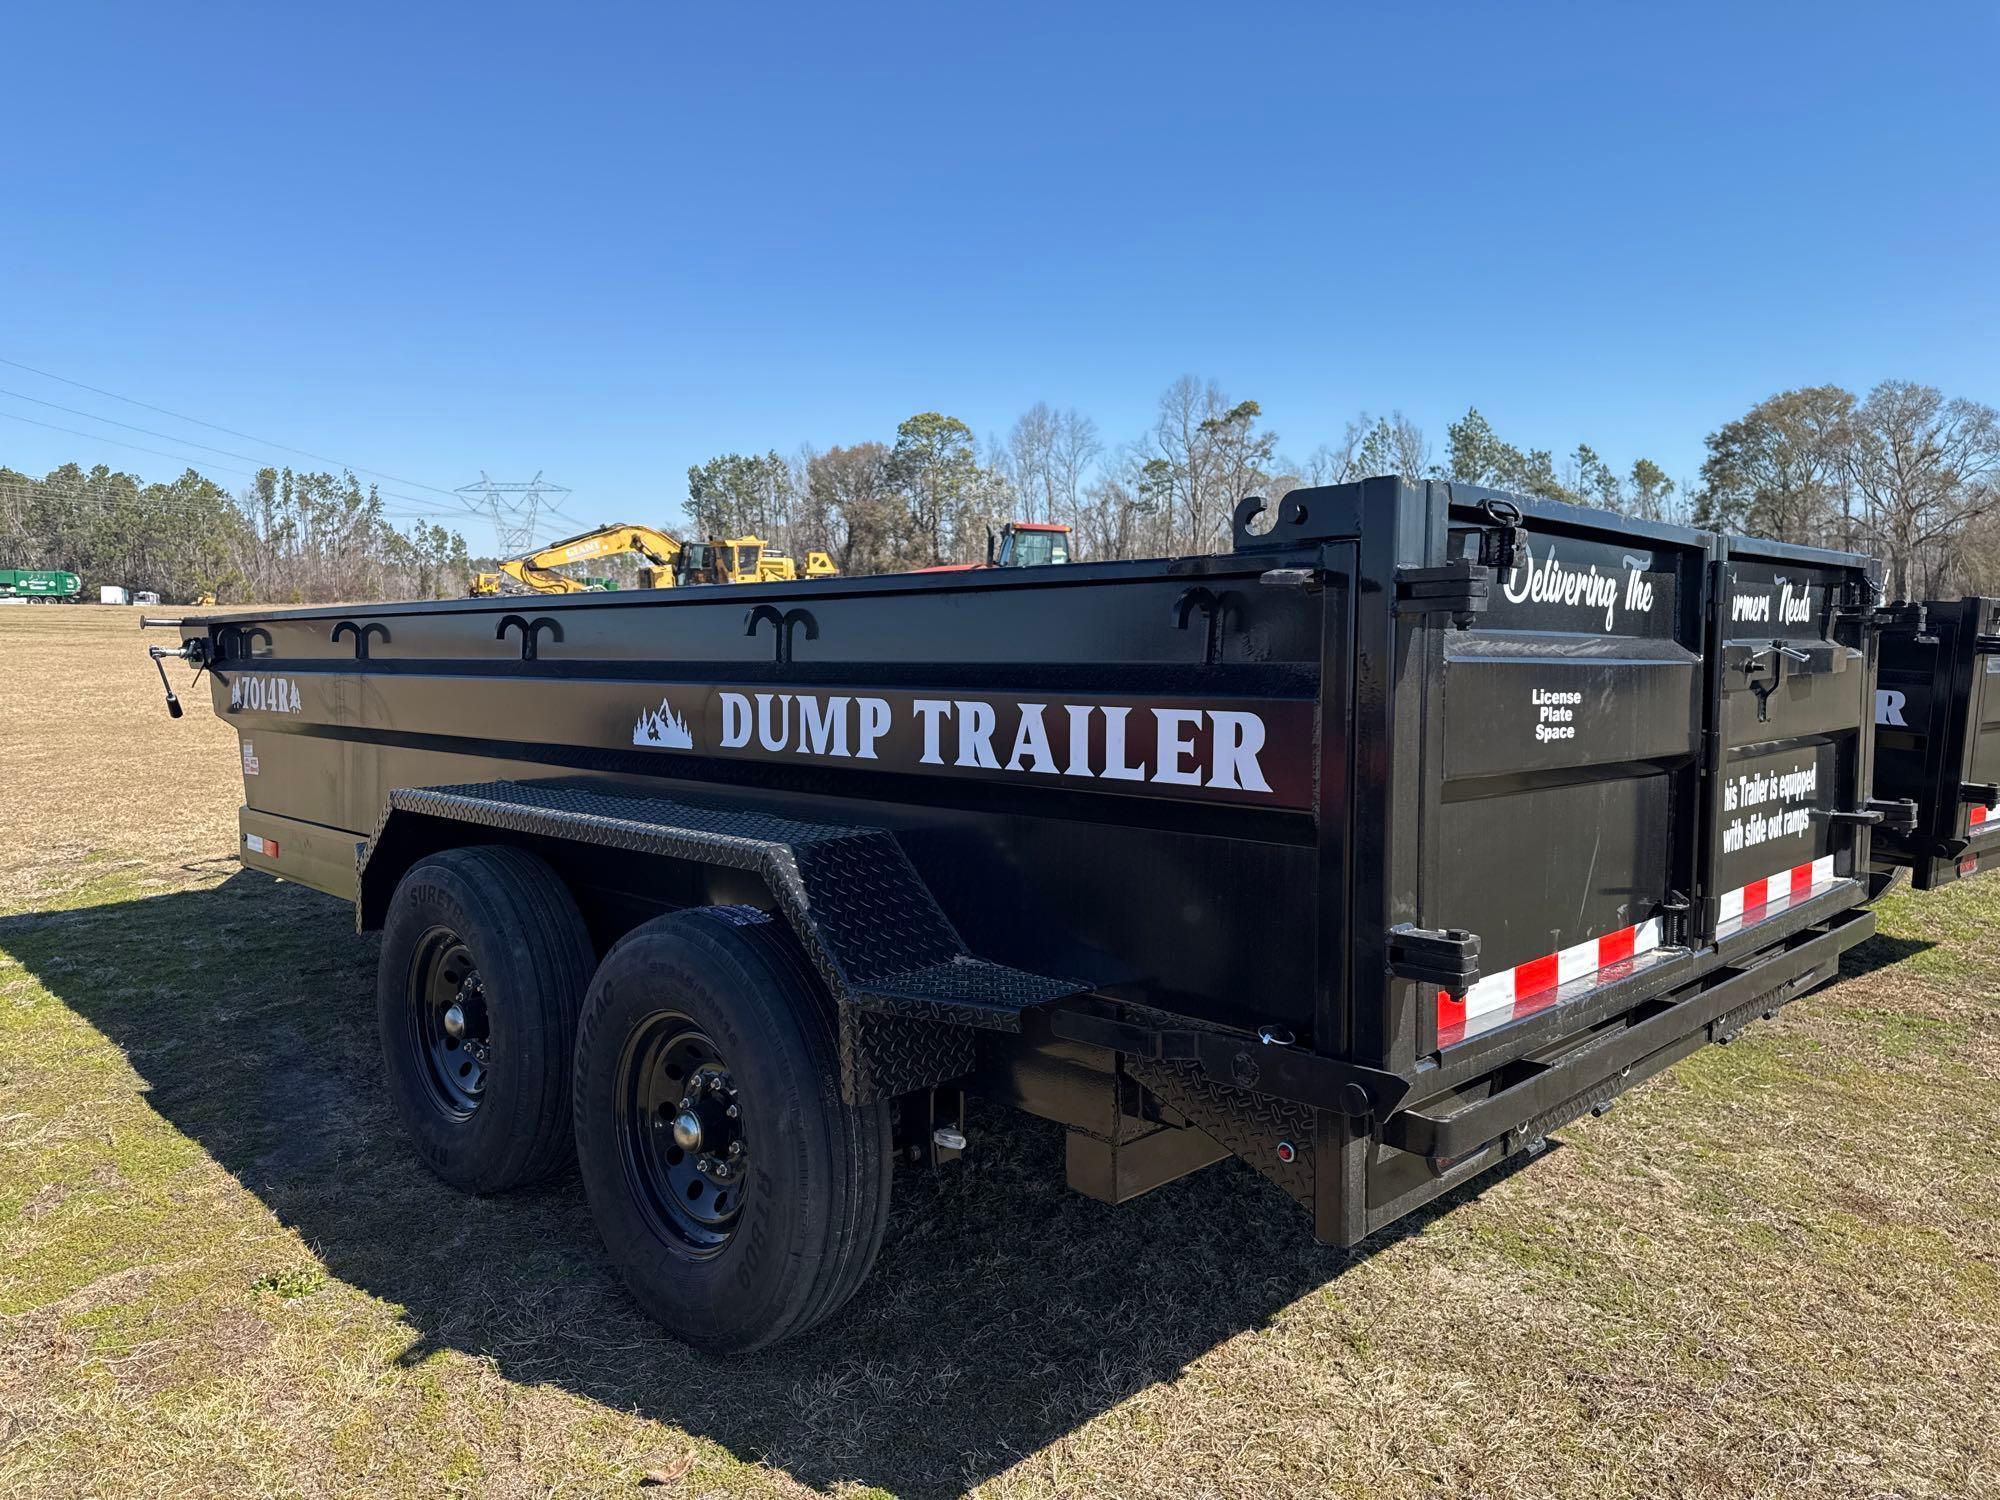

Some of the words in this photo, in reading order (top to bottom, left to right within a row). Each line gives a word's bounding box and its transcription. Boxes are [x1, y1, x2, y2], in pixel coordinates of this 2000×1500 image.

[1503, 544, 1618, 631] Delivering
[1623, 555, 1653, 612] The
[1774, 573, 1810, 625] Needs
[242, 677, 290, 712] 7014R
[1532, 688, 1582, 705] License
[1540, 706, 1573, 722] Plate
[719, 692, 892, 759] DUMP
[913, 699, 1273, 792] TRAILER
[1535, 723, 1575, 743] Space
[1724, 778, 1738, 811] his
[1740, 772, 1769, 808] Trailer
[1769, 769, 1778, 800] is
[1779, 761, 1816, 804] equipped
[1723, 818, 1744, 853] with
[1745, 812, 1767, 847] slide
[1767, 807, 1783, 840] out
[1783, 807, 1810, 838] ramps
